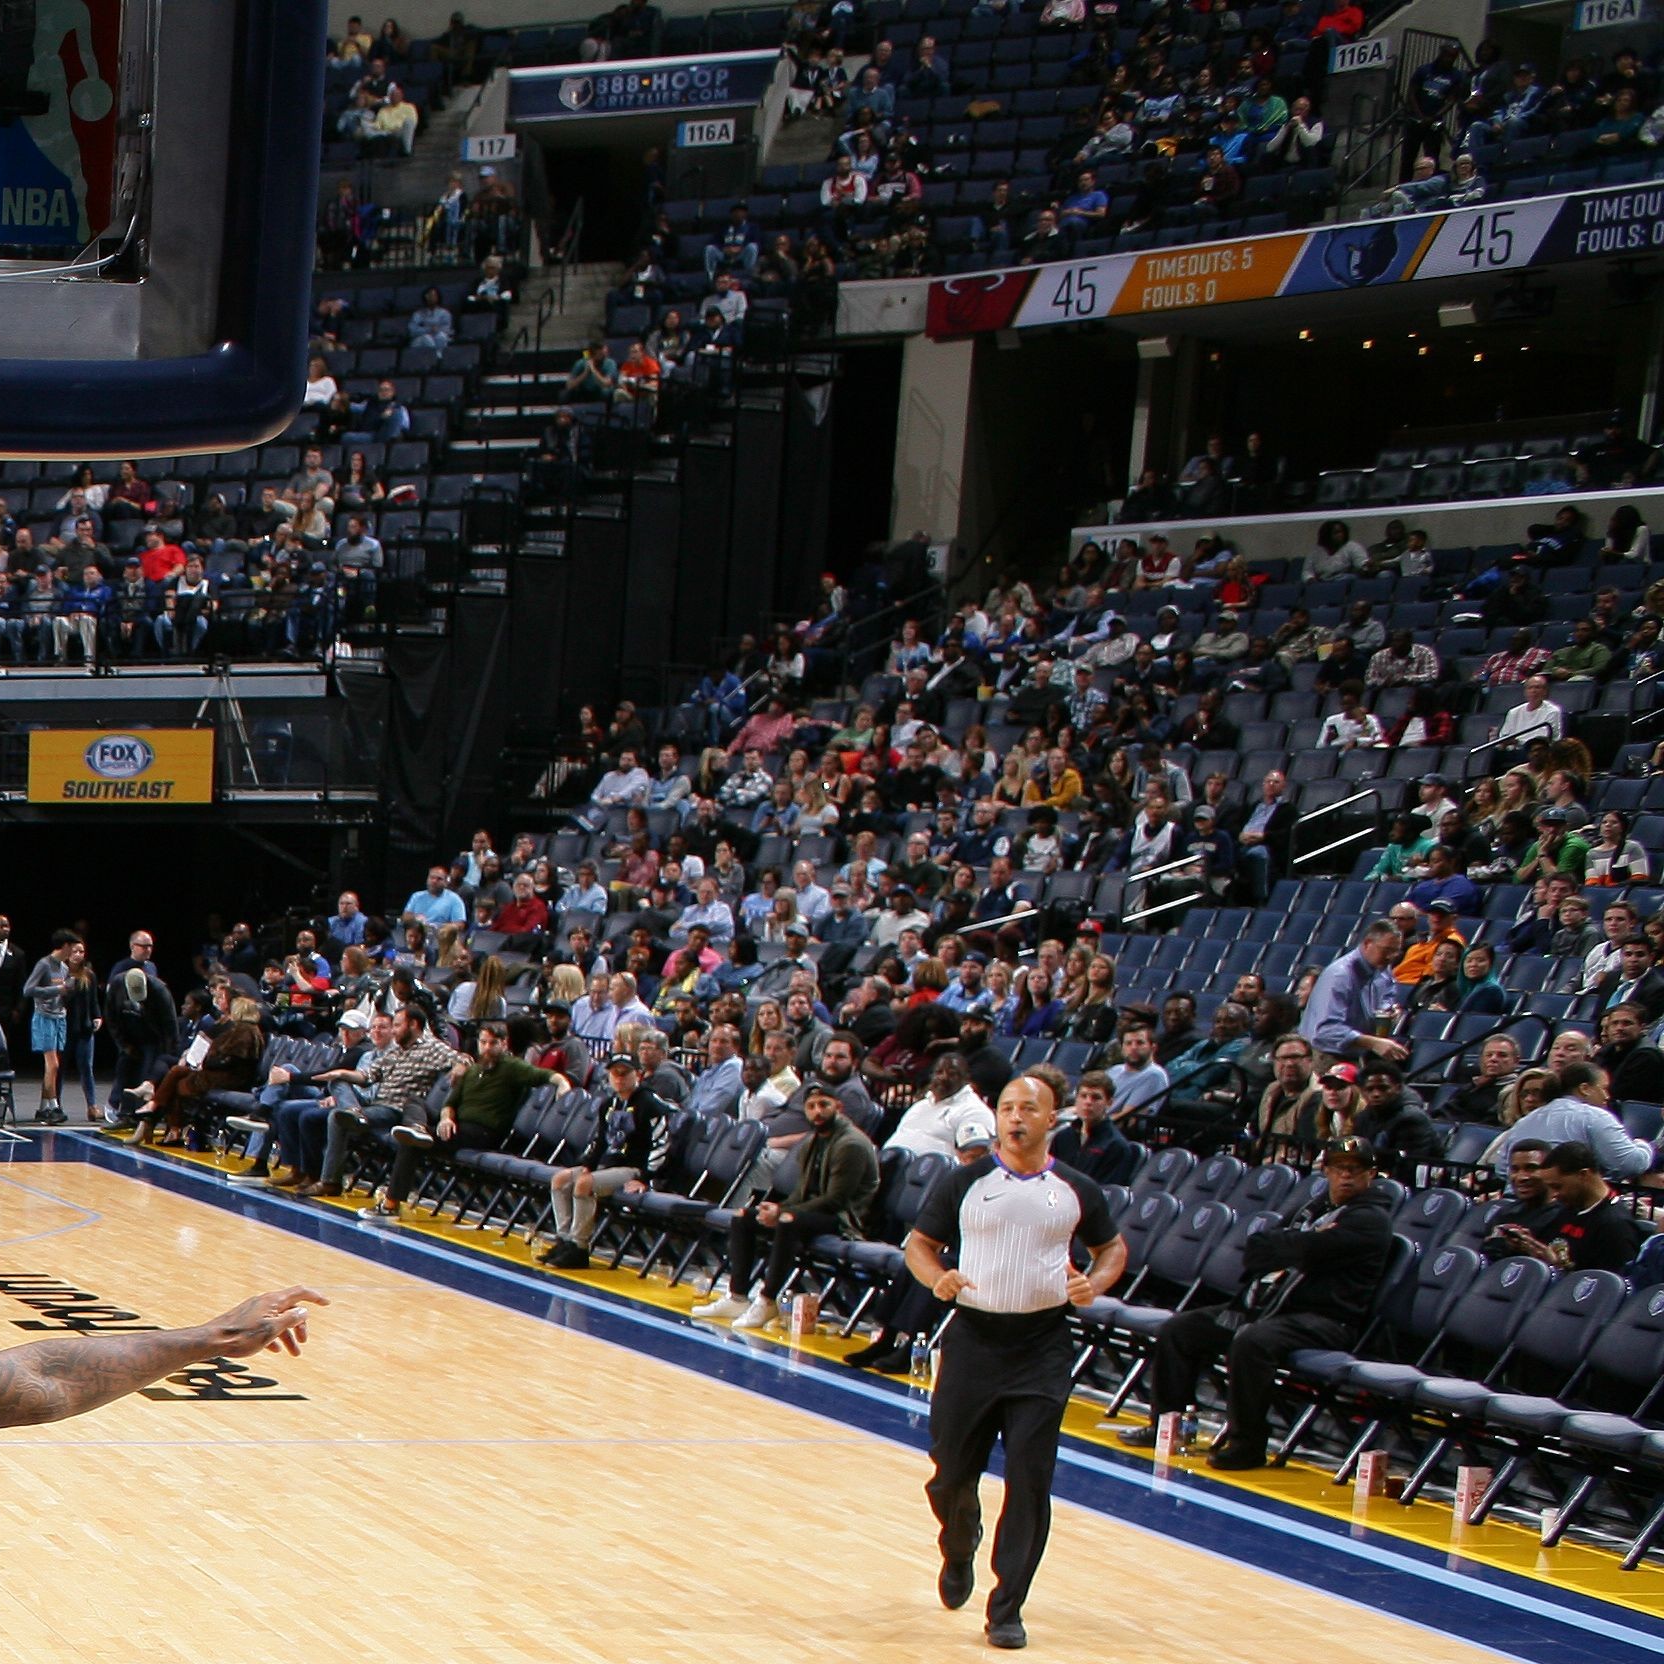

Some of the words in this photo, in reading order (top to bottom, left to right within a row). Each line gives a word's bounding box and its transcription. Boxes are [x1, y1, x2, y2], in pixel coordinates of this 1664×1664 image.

[1337, 45, 1383, 67] 116A
[478, 138, 506, 155] 117
[687, 122, 730, 142] 116A
[1, 187, 70, 226] NBA
[1582, 190, 1664, 224] TIMEOU
[1458, 210, 1515, 268] 45
[1576, 223, 1645, 254] FOULS:
[1147, 250, 1237, 281] TIMEOUTS:
[1241, 247, 1254, 270] 5
[1051, 266, 1098, 317] 45
[1142, 284, 1201, 309] FOULS:
[1205, 280, 1217, 302] 0
[100, 744, 138, 762] FOX
[63, 780, 174, 799] SOUTHEAST
